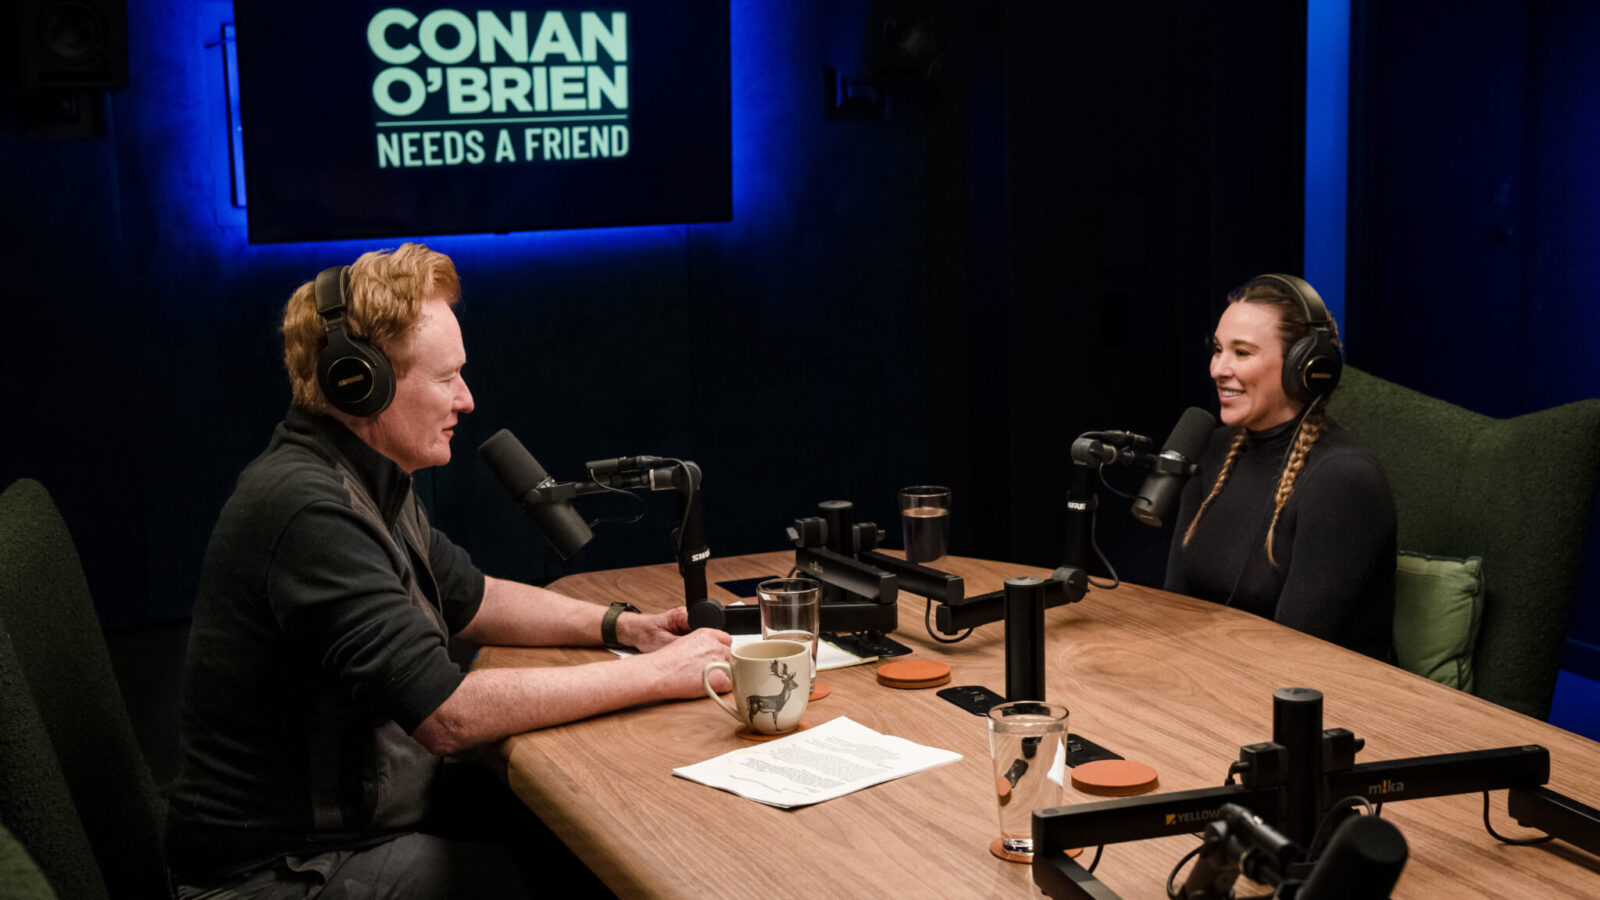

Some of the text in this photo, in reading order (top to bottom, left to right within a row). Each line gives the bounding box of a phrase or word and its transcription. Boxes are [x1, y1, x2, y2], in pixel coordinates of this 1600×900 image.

[367, 8, 627, 64] CONAN
[372, 65, 628, 116] O’BRIEN
[377, 124, 629, 168] NEEDS A FRIEND
